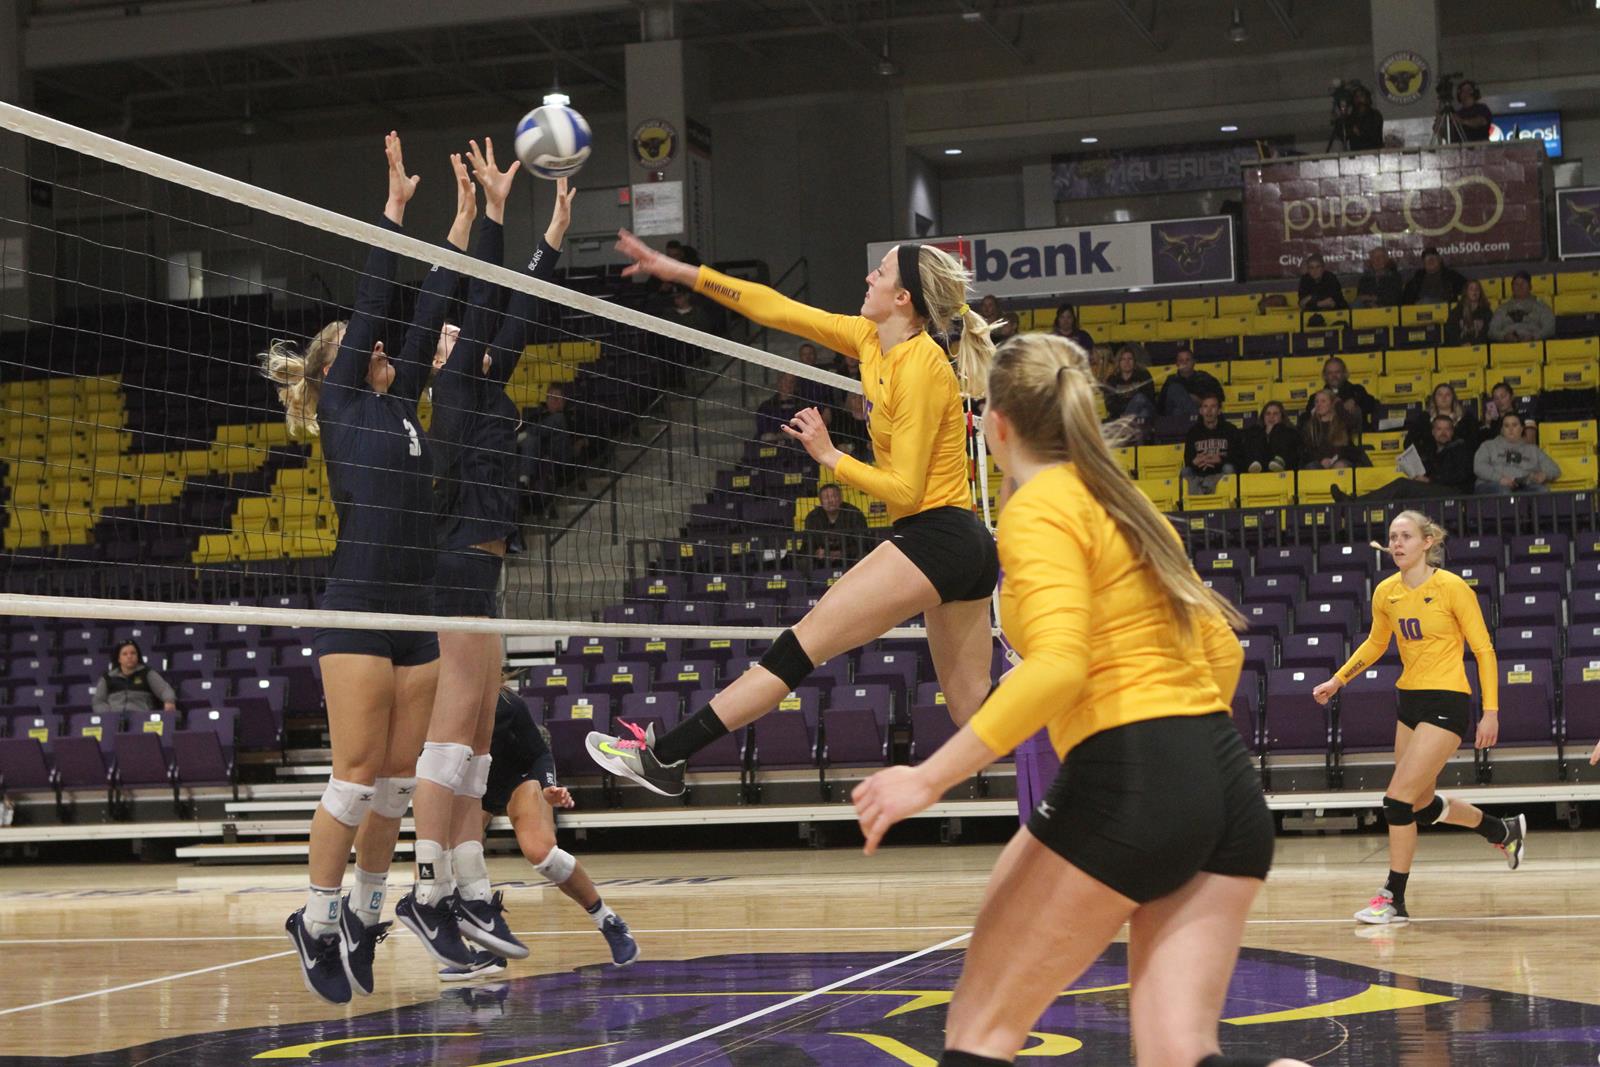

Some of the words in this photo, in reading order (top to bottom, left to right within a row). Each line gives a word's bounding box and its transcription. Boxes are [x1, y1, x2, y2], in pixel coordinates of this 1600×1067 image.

[1283, 185, 1373, 242] pub
[527, 248, 544, 271] BEARS
[974, 231, 1114, 282] bank
[1280, 254, 1303, 267] City
[402, 418, 421, 456] 3
[1398, 618, 1423, 640] 10
